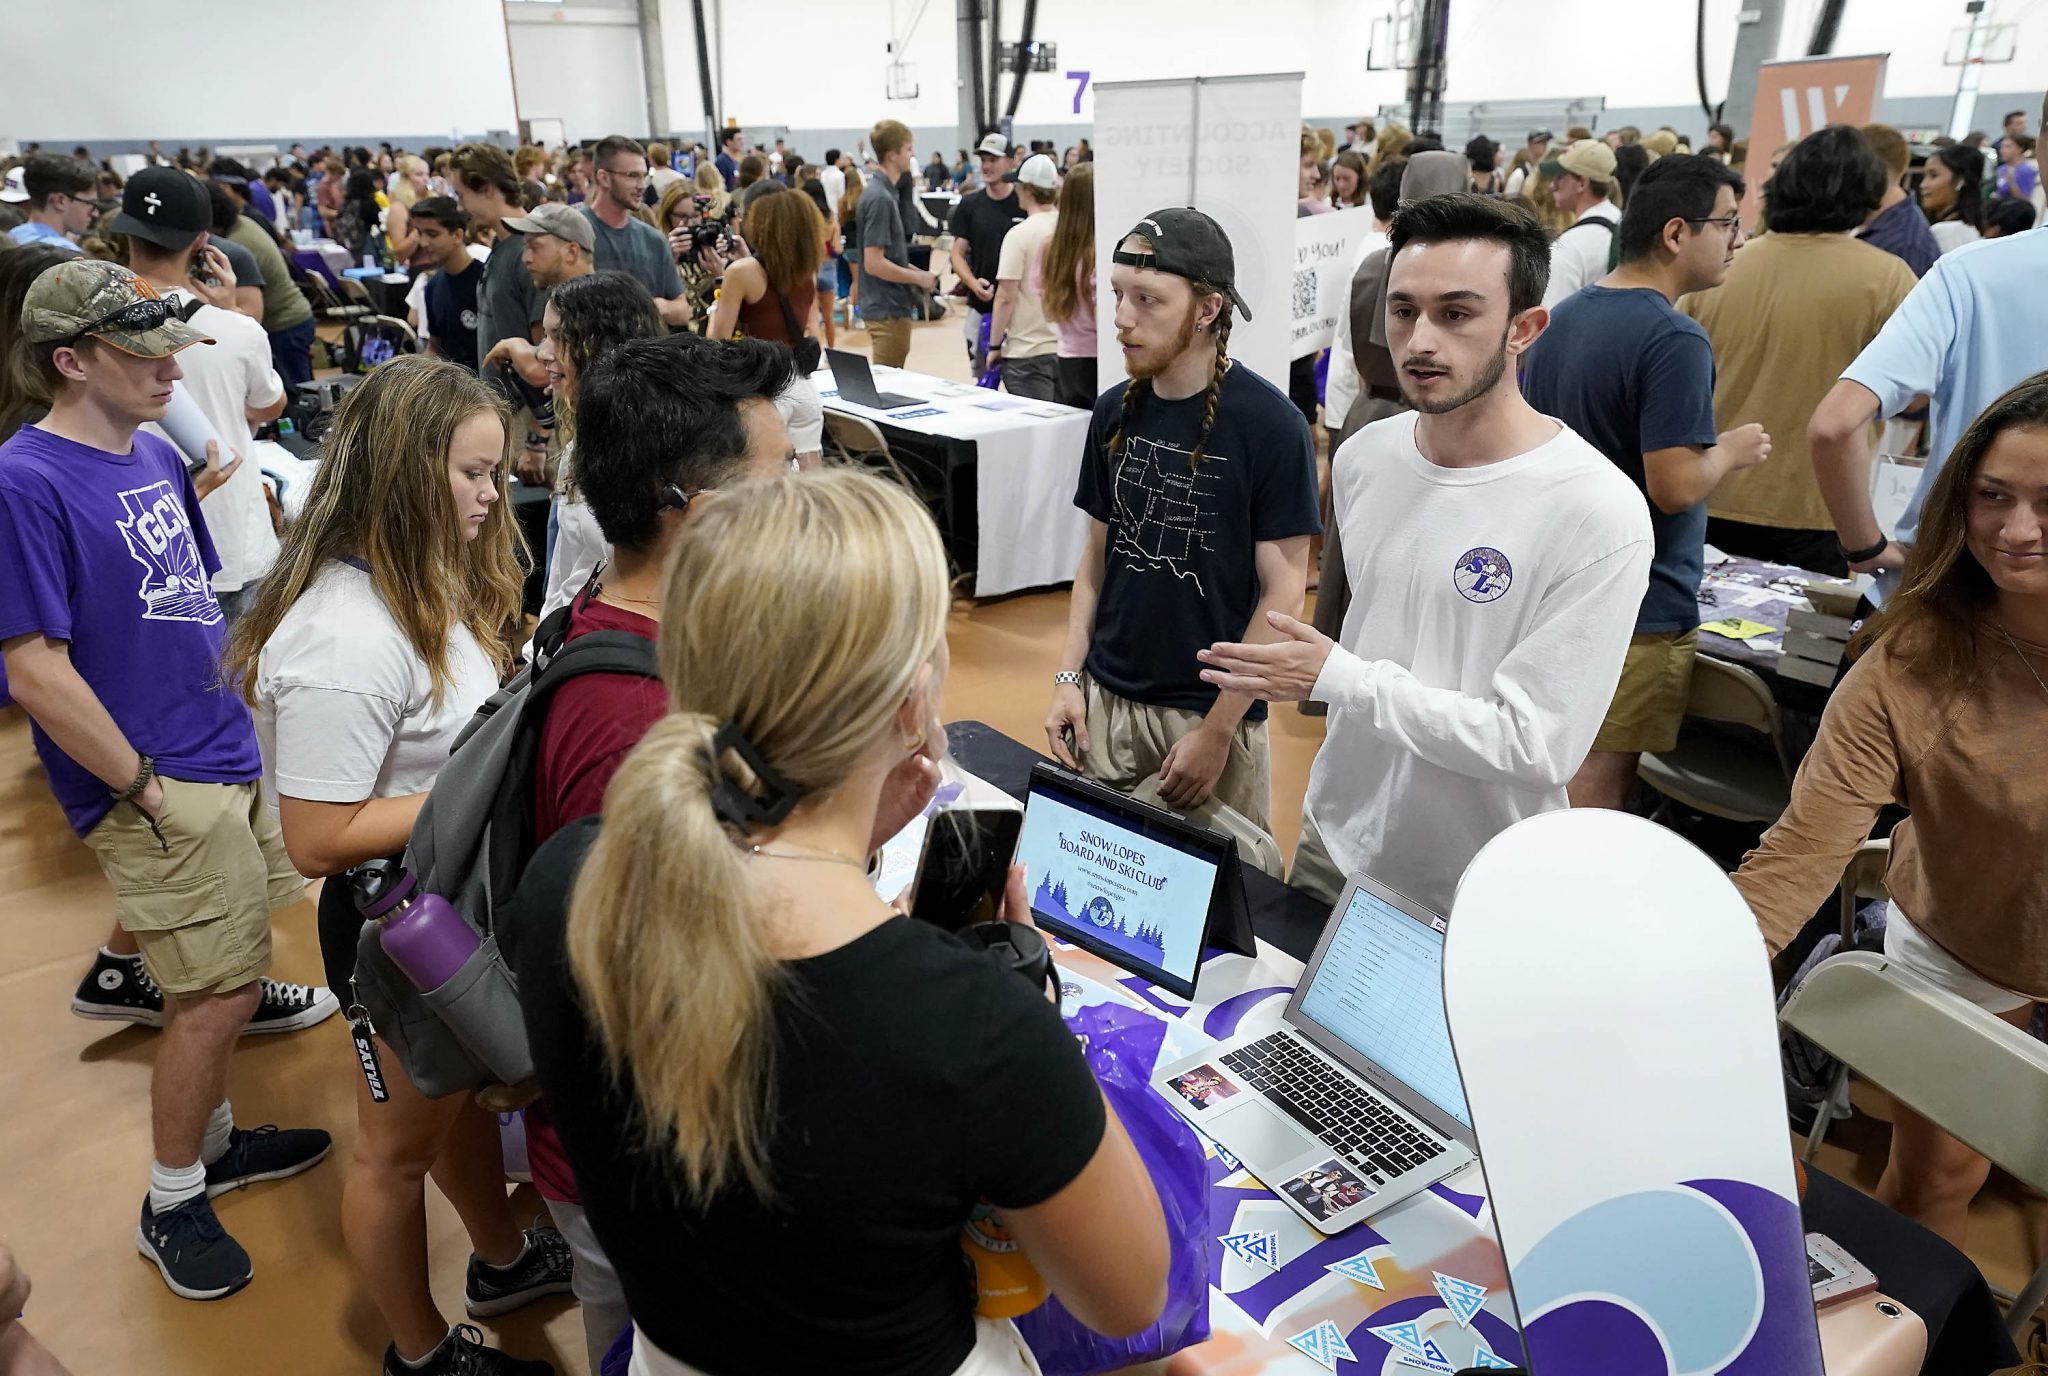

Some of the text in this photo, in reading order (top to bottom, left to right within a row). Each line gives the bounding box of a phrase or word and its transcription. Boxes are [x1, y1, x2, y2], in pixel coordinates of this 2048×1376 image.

[1066, 71, 1090, 114] 7
[136, 492, 190, 556] GCU
[1059, 838, 1162, 891] BOARD AND SKI CLUB
[1080, 830, 1146, 867] SNOW LOPES
[1334, 1265, 1379, 1287] SNOWBOWL
[1377, 1329, 1424, 1357] SNOWBOWL
[1403, 1356, 1456, 1375] SNOWBOWL
